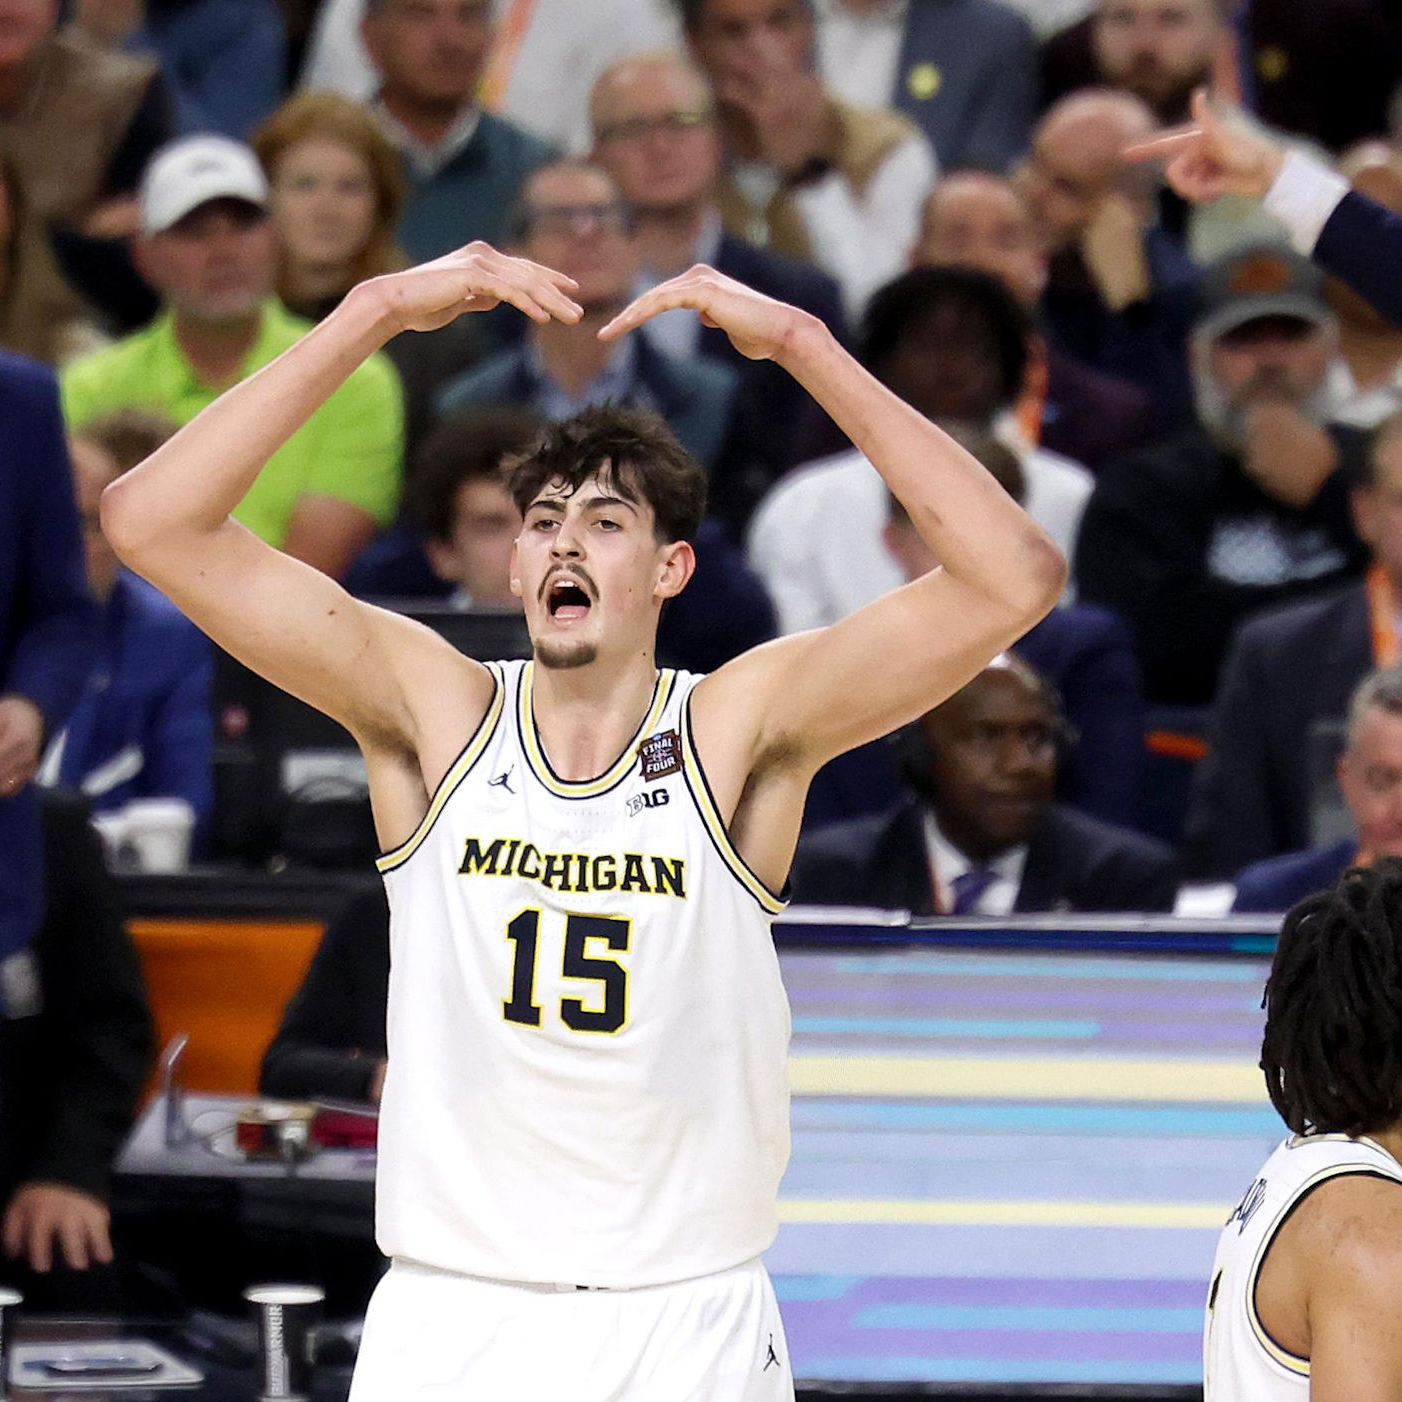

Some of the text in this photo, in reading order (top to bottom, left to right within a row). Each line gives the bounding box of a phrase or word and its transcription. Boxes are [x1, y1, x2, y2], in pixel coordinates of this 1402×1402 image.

[642, 738, 674, 756] FINAL
[646, 756, 677, 774] FOUR
[457, 837, 687, 900] MICHIGAN
[502, 906, 632, 1036] 15
